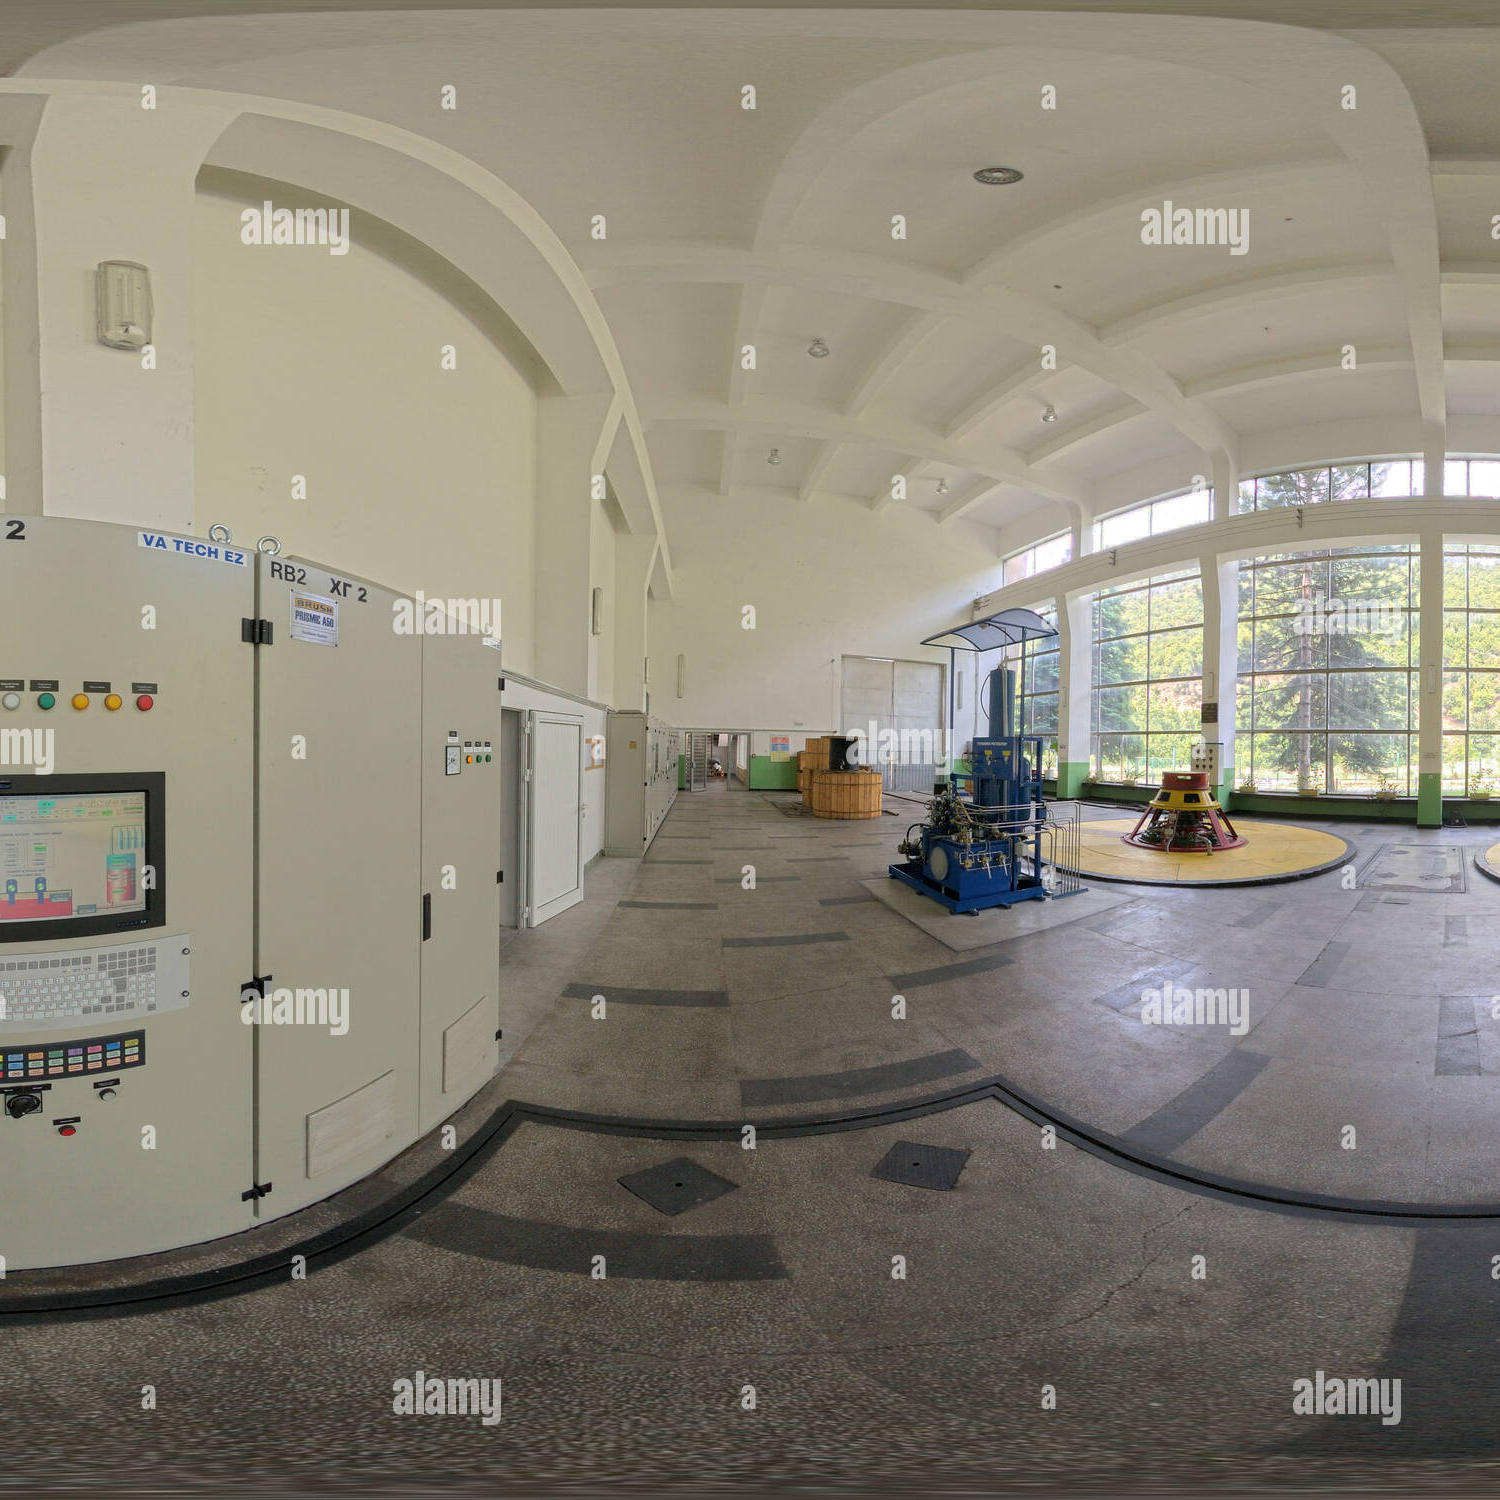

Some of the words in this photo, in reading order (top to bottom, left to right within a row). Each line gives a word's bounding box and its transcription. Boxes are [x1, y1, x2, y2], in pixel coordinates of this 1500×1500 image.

[5, 520, 26, 540] 2
[142, 533, 167, 549] VA
[172, 539, 219, 559] TECH
[224, 550, 244, 565] EZ
[270, 561, 307, 585] RB2
[330, 577, 352, 598] ХГ
[357, 587, 368, 603] 2
[297, 599, 333, 614] BRUSH
[295, 610, 321, 625] PRISMIC
